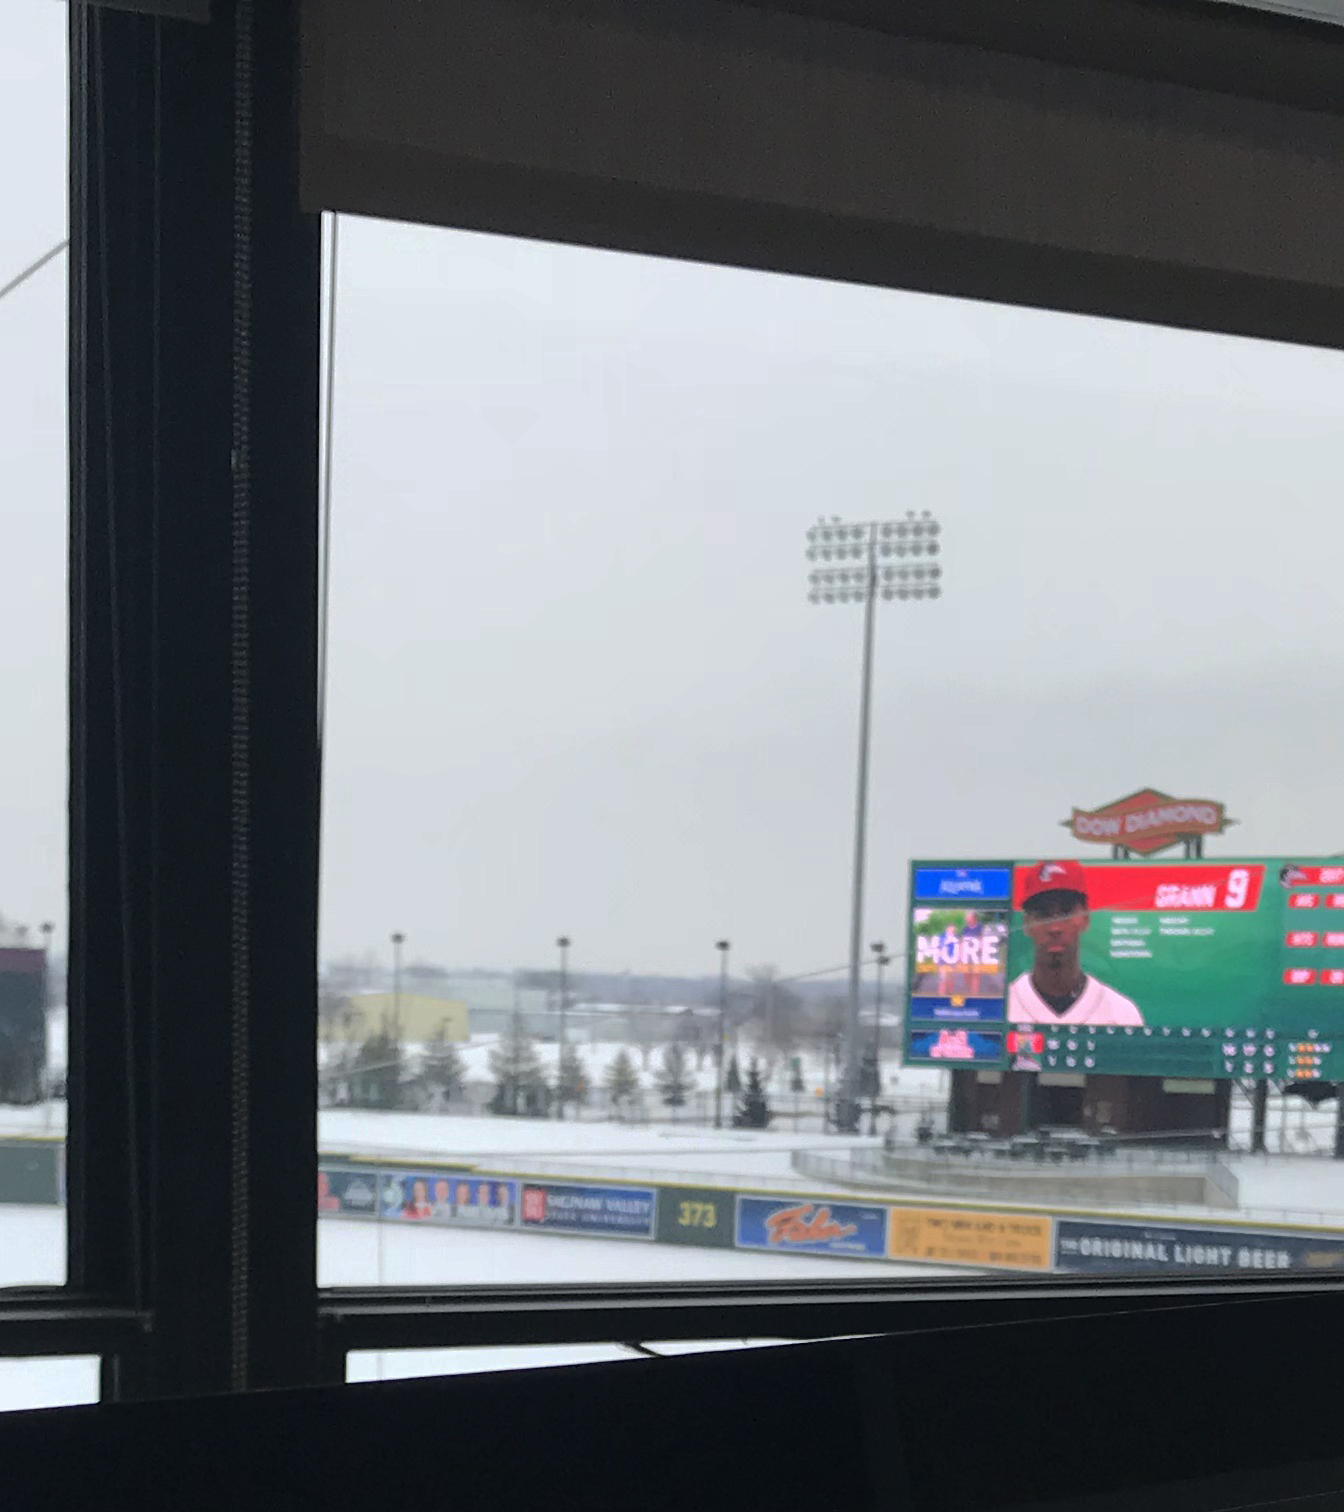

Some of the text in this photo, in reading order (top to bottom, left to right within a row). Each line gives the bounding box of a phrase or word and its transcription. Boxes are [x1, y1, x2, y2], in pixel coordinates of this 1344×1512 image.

[1077, 805, 1217, 836] DOW DIAMOND
[1225, 869, 1249, 908] 9
[916, 936, 999, 965] MORE
[679, 1202, 716, 1227] 373
[1079, 1239, 1169, 1262] ORIGINAL
[1174, 1245, 1232, 1266] LIGHT
[1237, 1248, 1289, 1269] BEER
